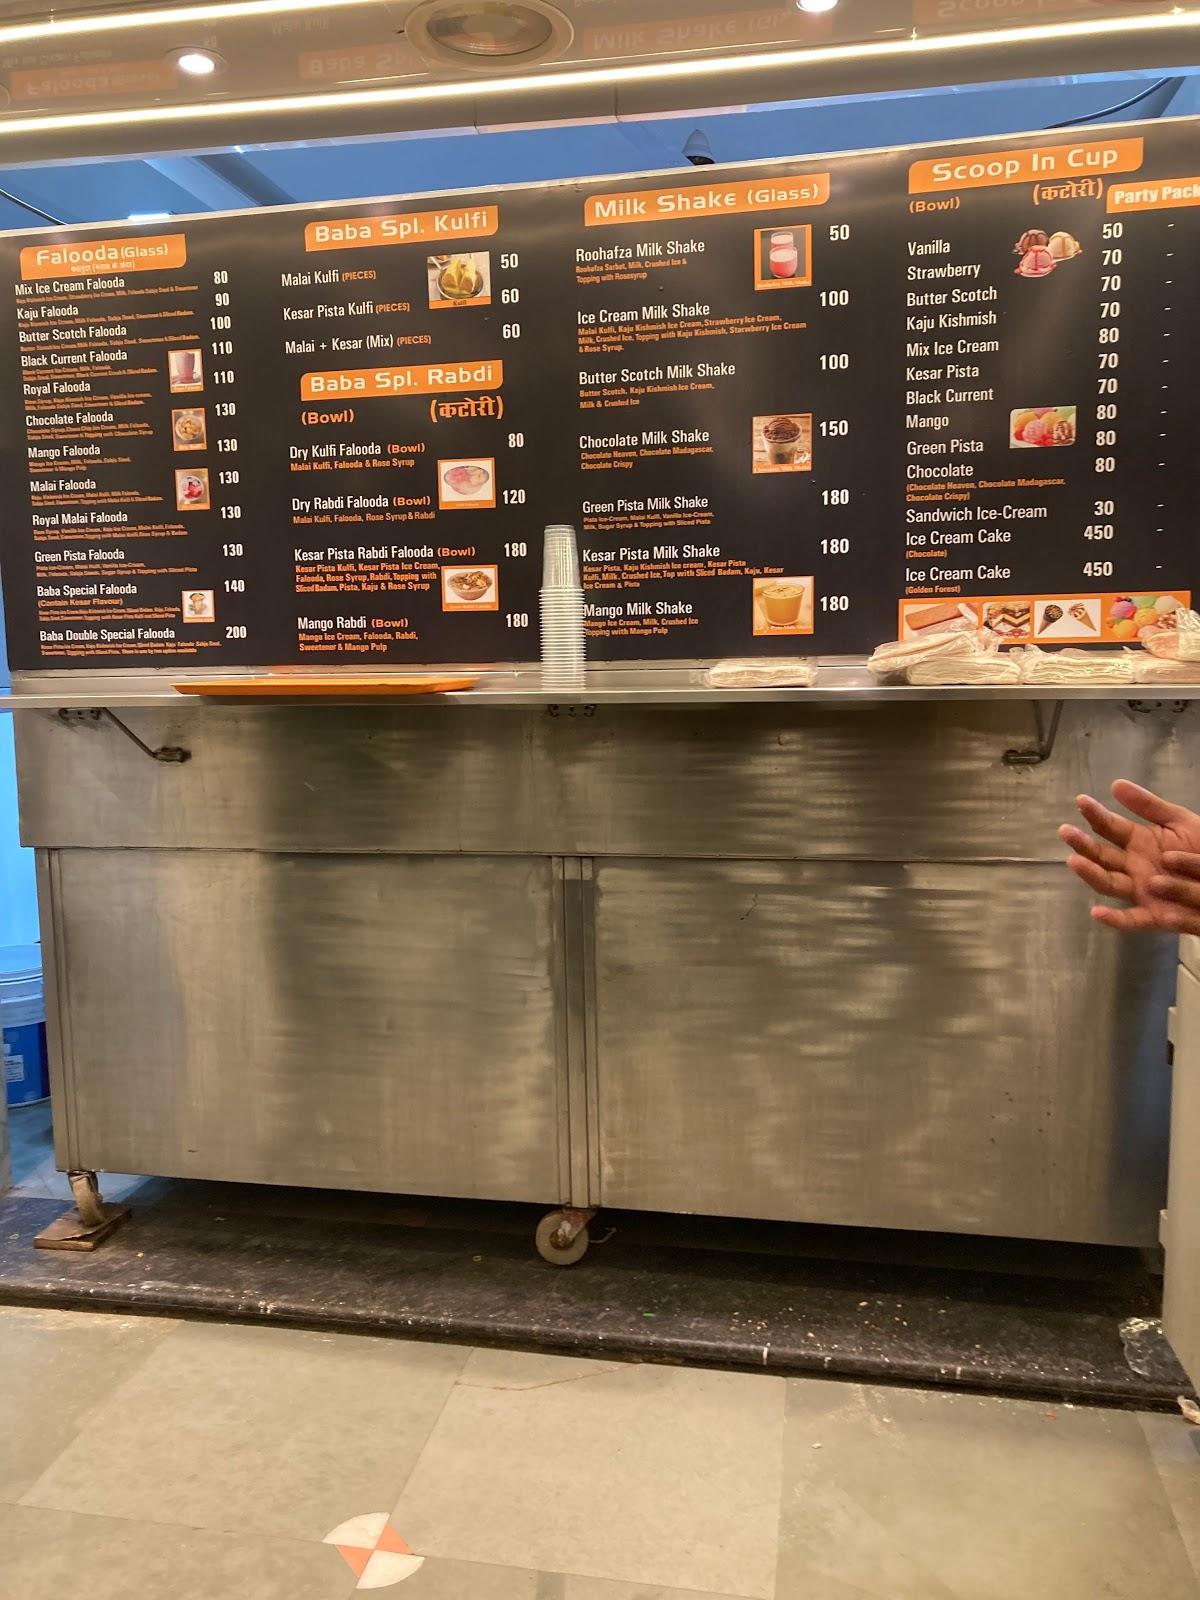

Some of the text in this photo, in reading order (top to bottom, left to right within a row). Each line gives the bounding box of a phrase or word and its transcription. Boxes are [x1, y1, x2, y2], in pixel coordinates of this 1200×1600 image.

[932, 149, 1118, 183] Scoop In Cup
[1033, 178, 1103, 205] (कटोरी)
[1114, 188, 1159, 205] Party
[595, 184, 819, 218] Milk Shake (Glass)
[909, 197, 960, 214] (Bowl)
[316, 212, 487, 243] Baba Spl. Kulfi
[830, 224, 849, 241] 50
[1102, 223, 1123, 238] 50
[37, 243, 168, 265] Falooda (Glass)
[576, 239, 705, 262] Roohafza Milk Shake
[908, 240, 950, 256] Vanilla
[501, 253, 519, 268] 50
[1102, 249, 1122, 265] 70
[214, 271, 228, 283] 80
[281, 270, 376, 287] Malai Kulfi (PIECES)
[907, 264, 981, 281] Strawberry
[15, 284, 33, 295] Mix
[36, 283, 50, 294] Ice
[53, 280, 84, 292] Cream
[87, 278, 125, 289] Falooda
[1101, 275, 1121, 292] 70
[215, 293, 230, 306] 90
[501, 289, 519, 303] 60
[819, 290, 848, 306] 100
[907, 287, 997, 307] Butter Scotch
[17, 308, 39, 321] Kaju
[41, 305, 78, 317] Falooda
[1100, 302, 1120, 318] 70
[906, 311, 997, 333] Kaju Kishmish
[502, 324, 520, 339] 60
[1099, 328, 1119, 344] 80
[212, 341, 233, 354] 110
[285, 340, 315, 354] Malai
[332, 337, 362, 351] Kesar
[366, 334, 394, 349] (Mix)
[397, 335, 431, 347] (PIECES)
[819, 353, 848, 370] 100
[1098, 353, 1119, 369] 70
[214, 371, 234, 384] 110
[311, 366, 492, 393] Baba Spl. Rabdi
[579, 362, 735, 385] Butter Scotch Milk Shake
[24, 381, 90, 396] Royal Falooda
[1098, 378, 1118, 394] 70
[906, 388, 994, 405] Black Current
[215, 403, 236, 416] 130
[302, 409, 354, 425] (Bowl)
[430, 396, 504, 422] (कटोरी)
[1097, 404, 1117, 420] 80
[26, 412, 113, 426] Chocolate Falooda
[819, 420, 848, 437] 150
[217, 439, 237, 452] 130
[508, 433, 524, 447] 80
[579, 428, 709, 449] Chocolate Milk Shake
[1096, 430, 1116, 446] 80
[28, 446, 100, 459] Mango Falooda
[290, 443, 425, 460] Dry Kulfi Falooda (Bowl)
[907, 464, 973, 479] Chocolate
[1095, 457, 1115, 472] 80
[219, 471, 239, 484] 130
[292, 495, 431, 512] Dry Rabdi Falooda (Bowl)
[503, 490, 526, 504] 120
[821, 489, 849, 505] 180
[221, 506, 241, 519] 130
[906, 504, 1047, 523] Sandwich Ice-Cream
[1094, 501, 1114, 516] 30
[906, 529, 1011, 546] Ice Cream Cake
[1084, 525, 1113, 540] 450
[295, 545, 475, 561] Kesar Pista Rabdi Falooda (Bowl)
[504, 543, 527, 557] 180
[821, 538, 849, 554] 180
[906, 565, 1010, 582] Ice Cream Cake
[1083, 561, 1113, 577] 450
[37, 584, 137, 596] Baba Special Falooda
[224, 580, 245, 592] 140
[584, 601, 692, 619] Mango Milk Shake
[820, 595, 848, 611] 180
[298, 616, 408, 631] Mango Rabdi (Bowl)
[506, 613, 528, 627] 180
[40, 628, 175, 641] Baba Double Special Falooda
[226, 626, 246, 639] 200
